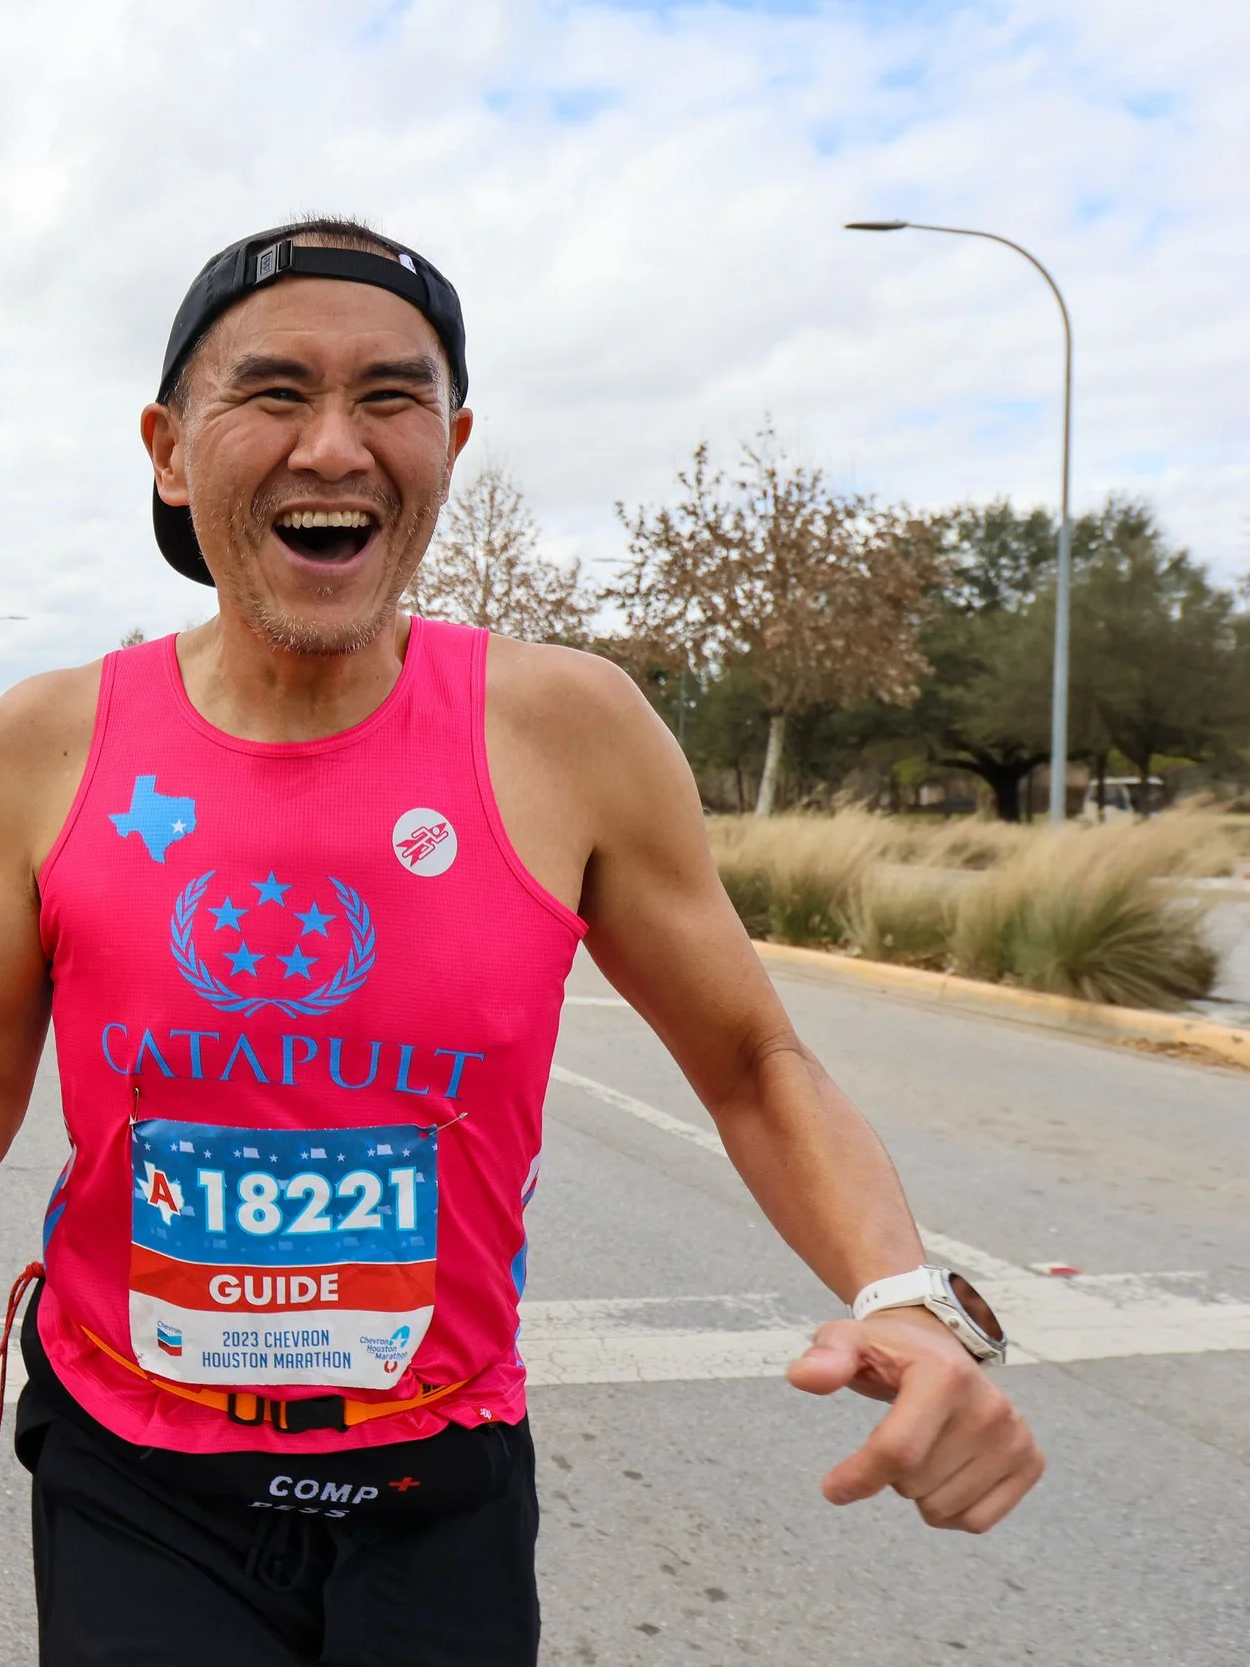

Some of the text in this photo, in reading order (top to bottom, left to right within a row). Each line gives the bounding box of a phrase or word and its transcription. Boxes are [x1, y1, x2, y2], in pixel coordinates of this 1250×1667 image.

[101, 1022, 484, 1100] CATAPULT
[149, 1165, 418, 1237] A 18221
[208, 1273, 339, 1306] GUIDE
[222, 1329, 330, 1348] 2023 CHEVRON
[359, 1336, 389, 1345] Chevron
[366, 1344, 397, 1353] Houston
[202, 1351, 351, 1369] HOUSTON MARATHON
[268, 1475, 379, 1504] COMP
